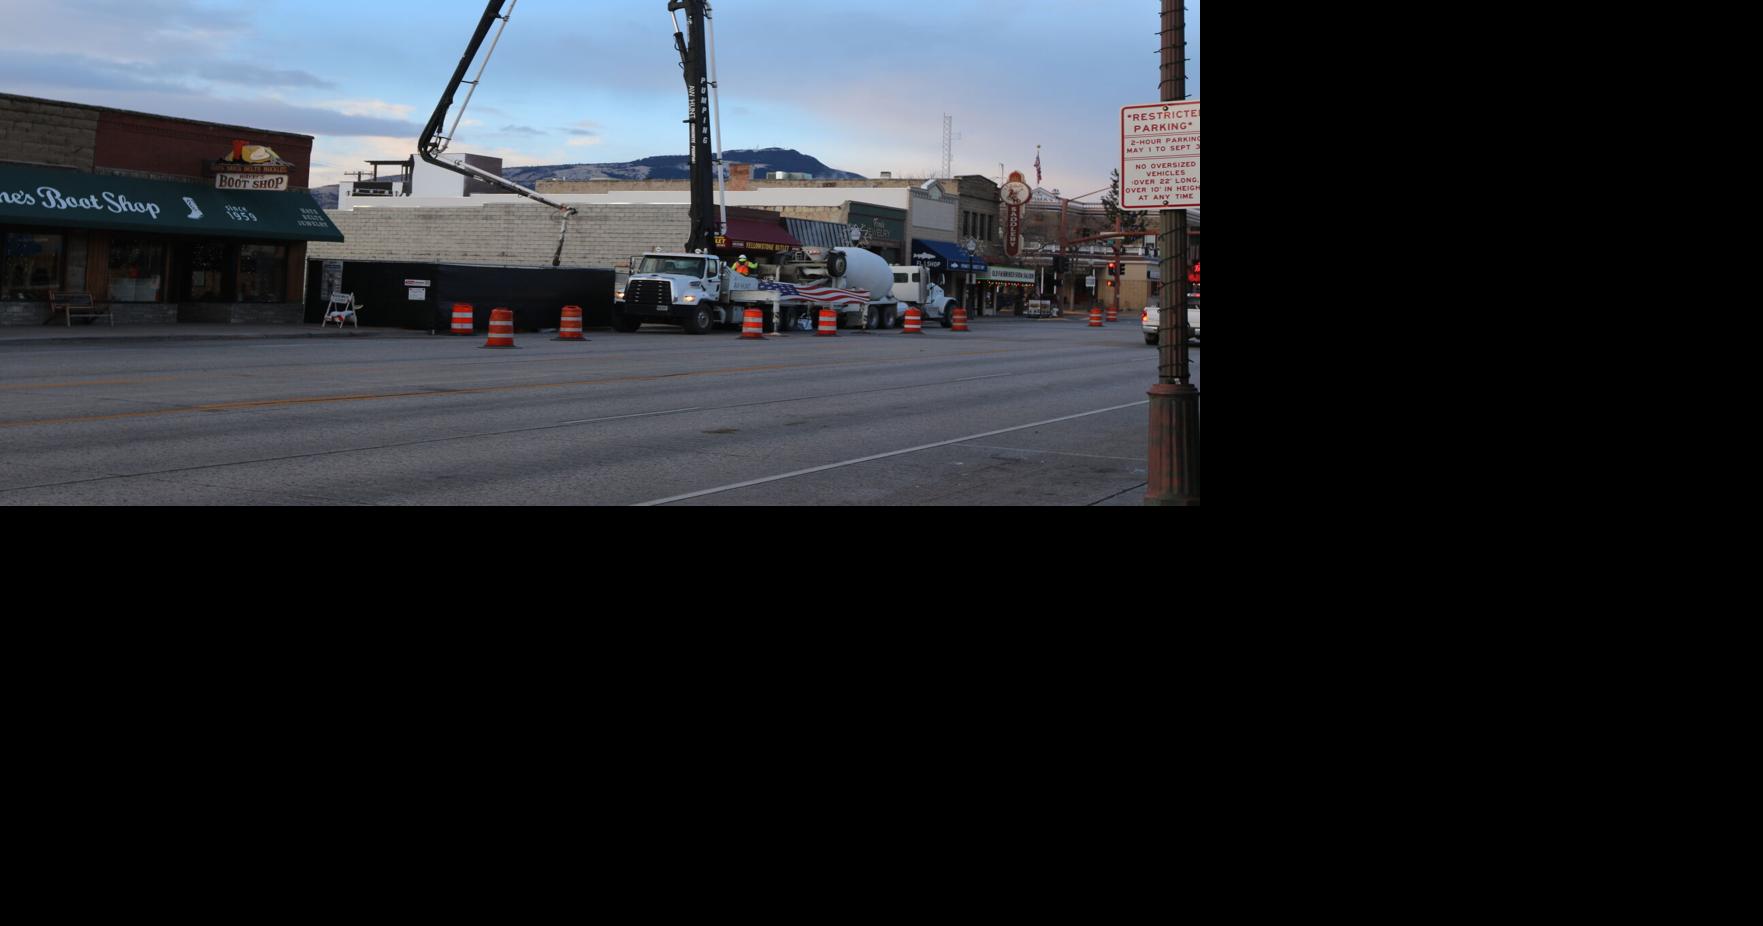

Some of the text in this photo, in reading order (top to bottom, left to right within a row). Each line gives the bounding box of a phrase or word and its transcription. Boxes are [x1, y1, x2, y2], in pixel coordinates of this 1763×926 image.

[700, 77, 709, 144] PUMPING
[1150, 161, 1196, 169] OVERSIZED
[219, 174, 284, 189] BOOT SHOP
[36, 186, 103, 209] Boot
[102, 191, 160, 219] Shop
[226, 210, 257, 222] 1959
[1010, 206, 1018, 247] SADDLERY
